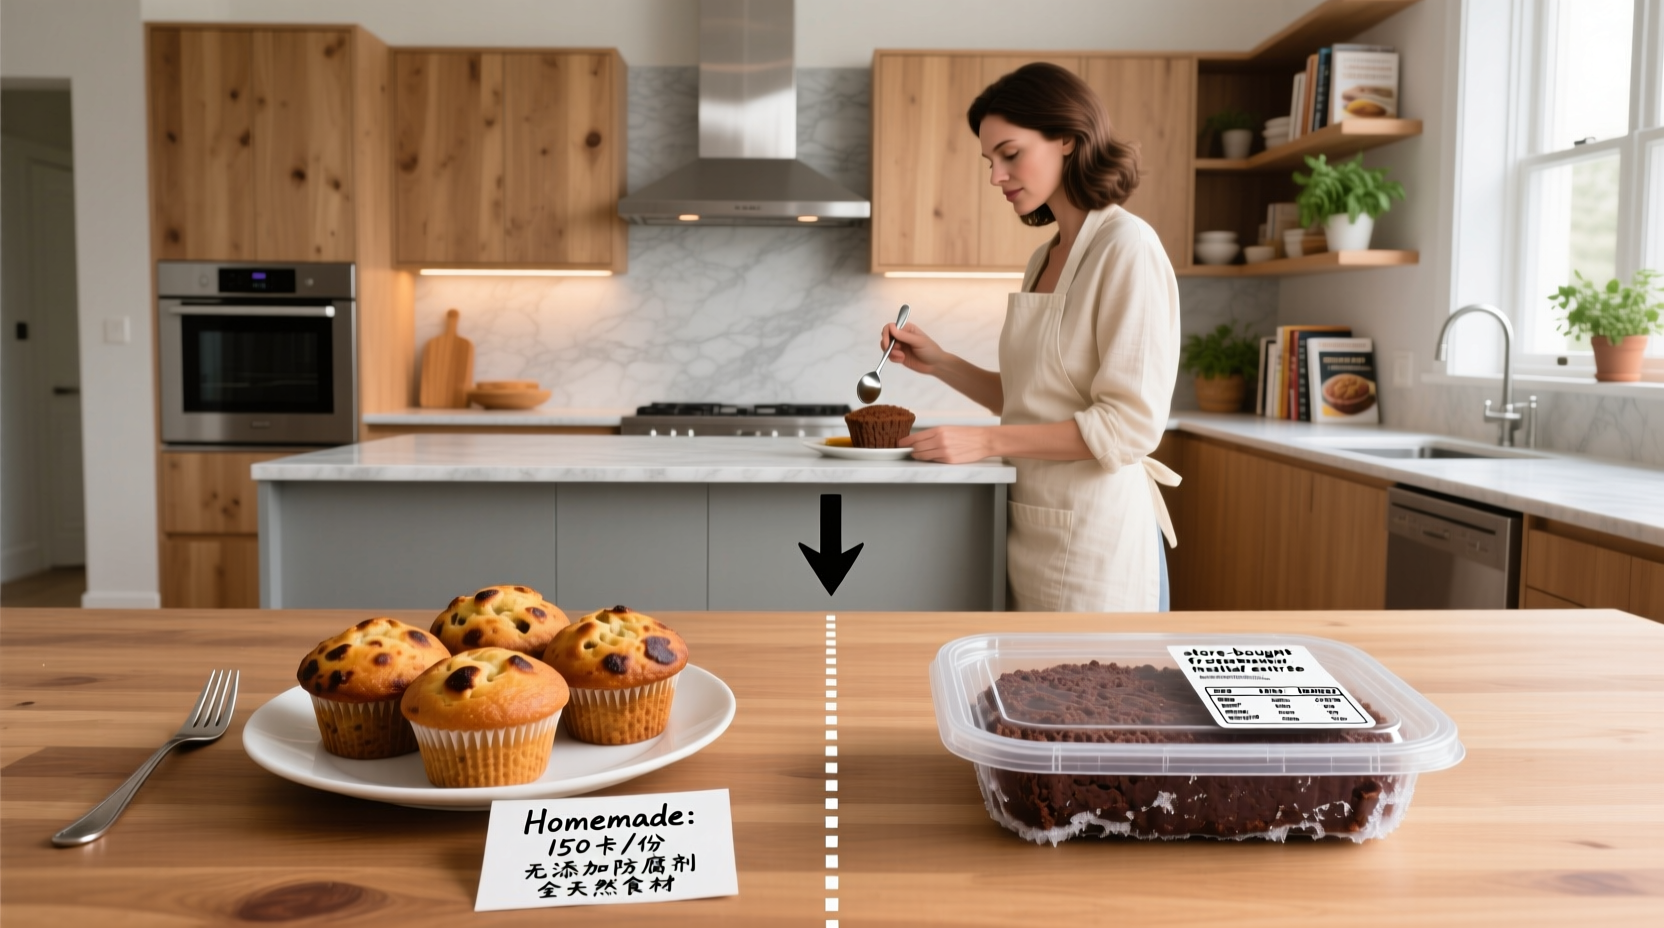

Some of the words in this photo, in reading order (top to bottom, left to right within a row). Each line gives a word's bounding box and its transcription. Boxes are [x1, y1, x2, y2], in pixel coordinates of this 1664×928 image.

[523, 803, 694, 835] Homemade:
[524, 853, 696, 880] 无添加防腐剂
[537, 874, 675, 899] 全天然食材
